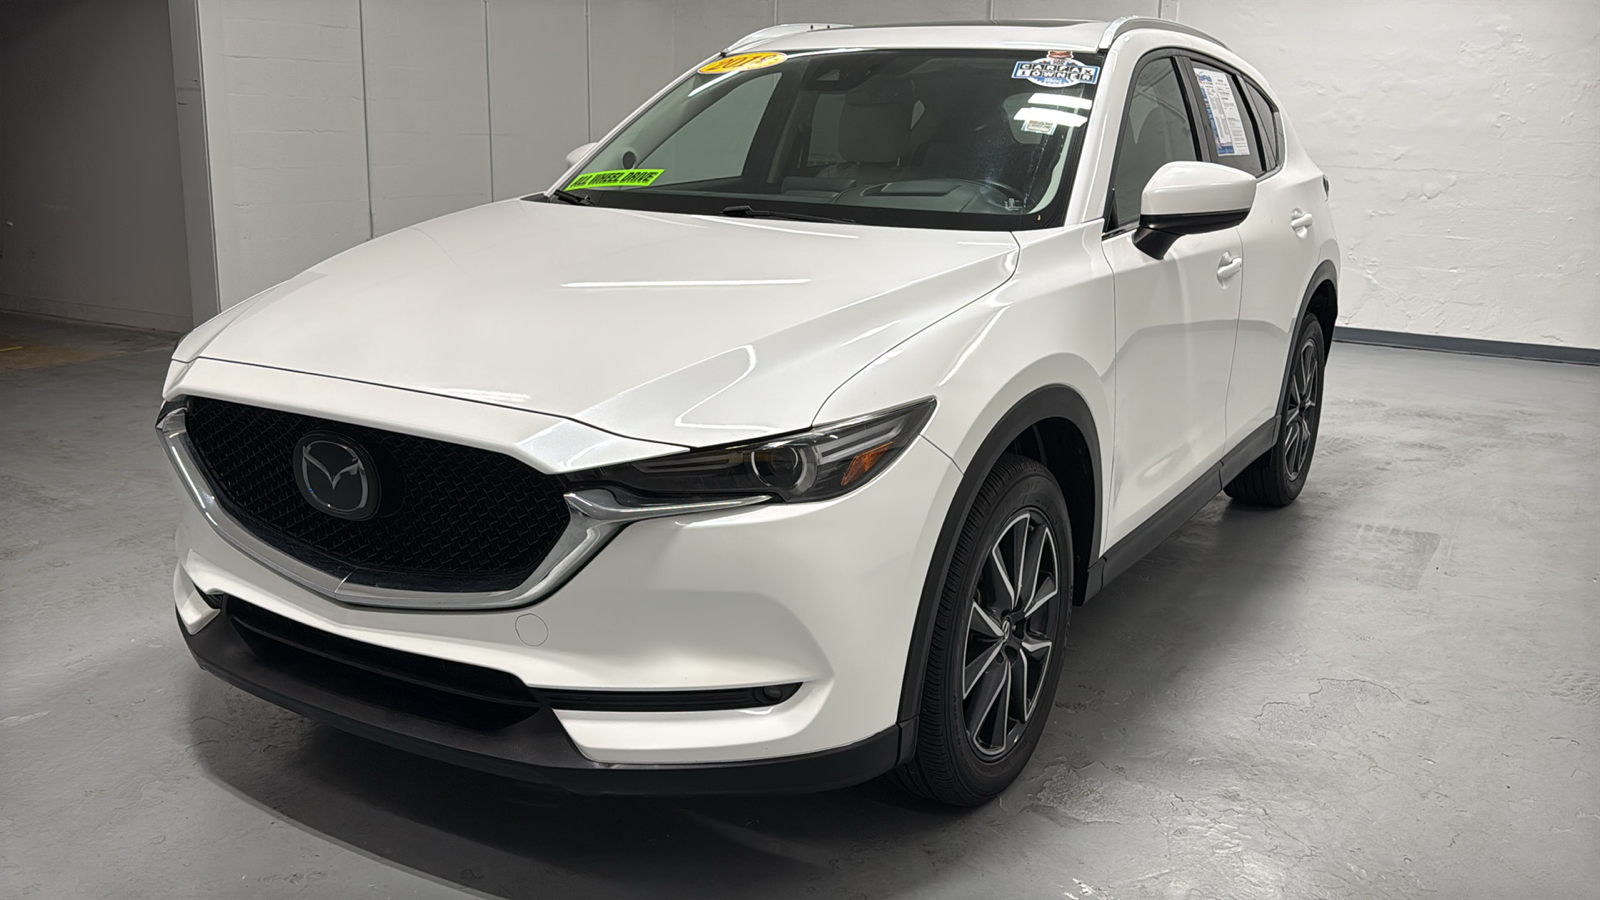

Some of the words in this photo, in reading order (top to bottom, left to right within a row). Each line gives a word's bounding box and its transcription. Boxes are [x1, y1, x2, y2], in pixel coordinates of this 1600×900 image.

[1019, 62, 1093, 76] CARFAX
[1031, 70, 1093, 81] OWNER
[569, 174, 594, 188] ALL
[588, 172, 626, 186] WHEEL
[619, 171, 660, 184] DRIVE
